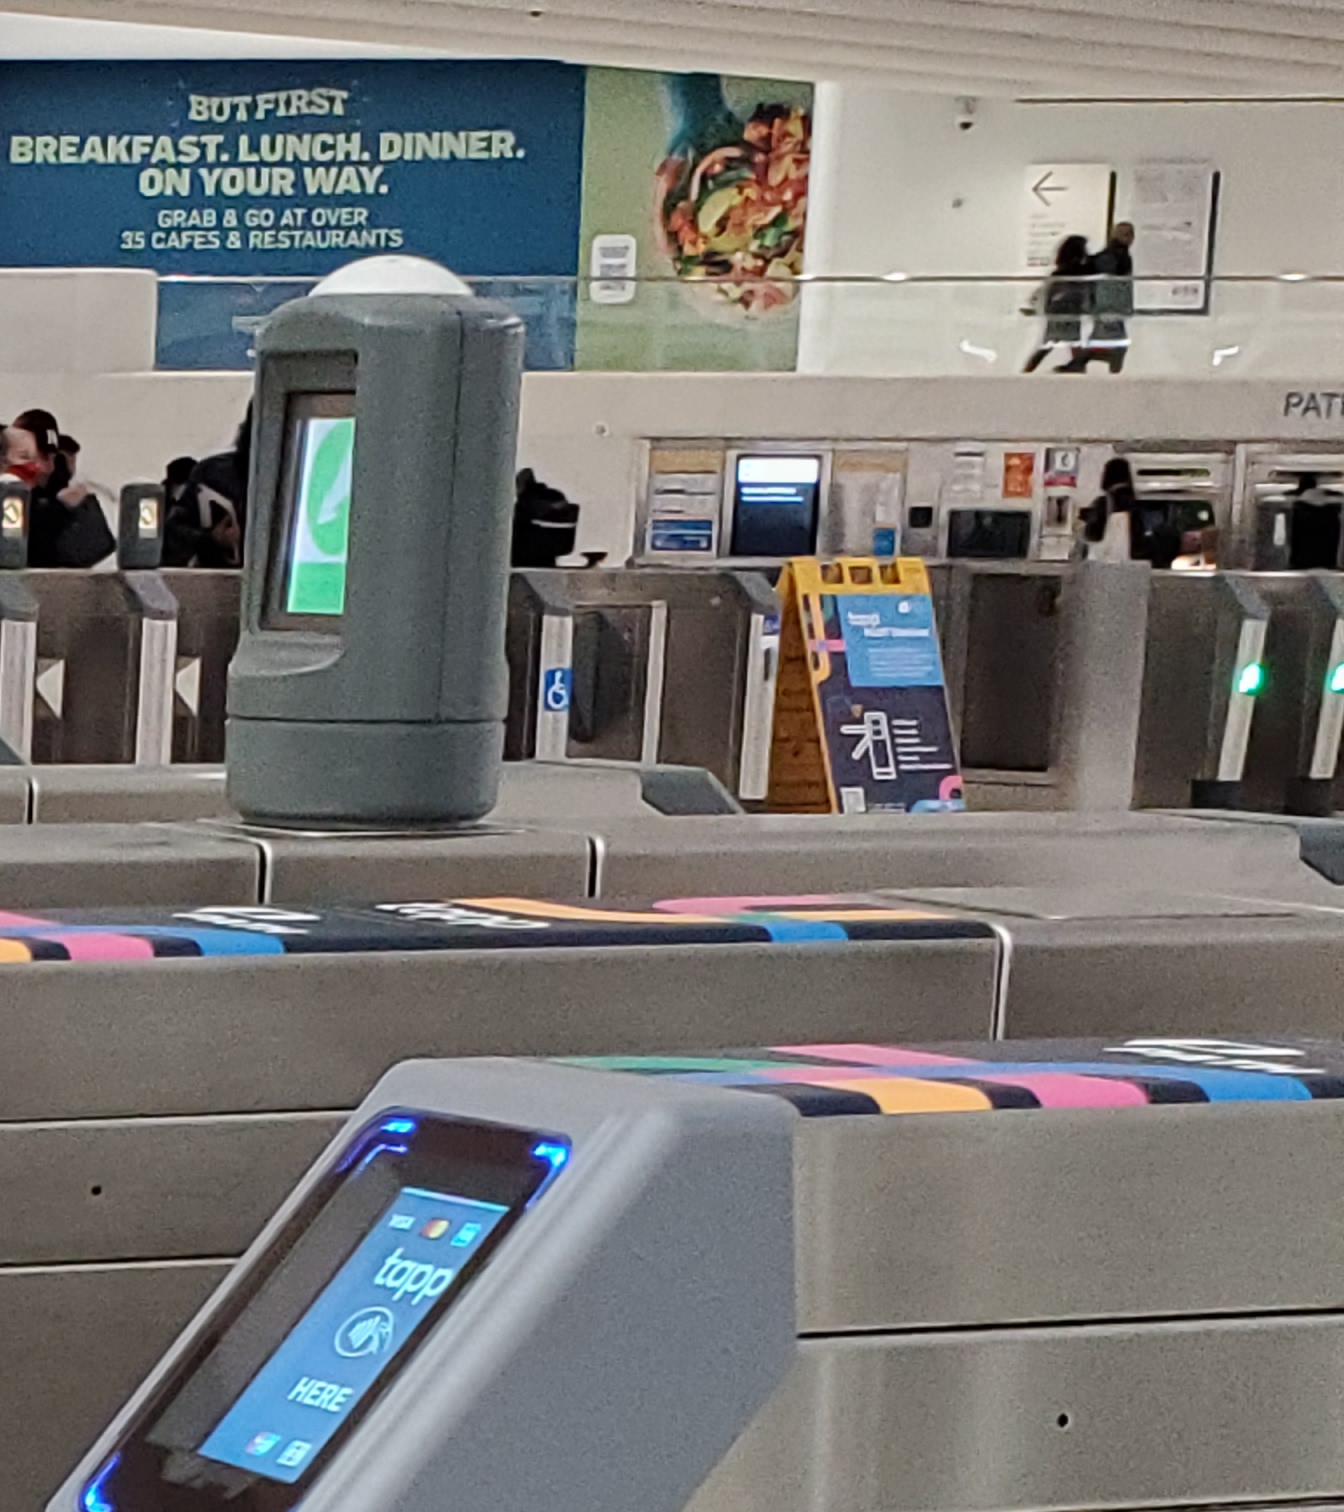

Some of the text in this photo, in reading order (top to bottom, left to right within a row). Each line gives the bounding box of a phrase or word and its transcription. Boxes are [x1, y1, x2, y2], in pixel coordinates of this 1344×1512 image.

[188, 88, 350, 122] BUT FIRST
[9, 130, 526, 164] BREAKFAST. LUNCH. DINNER.
[138, 165, 389, 197] ON YOUR WAY.
[157, 207, 369, 228] GRAB & GO AT OVER
[120, 228, 404, 250] 35 CAFES & RESTAURANTS
[375, 1248, 455, 1306] tapp
[288, 1376, 354, 1413] HERE
